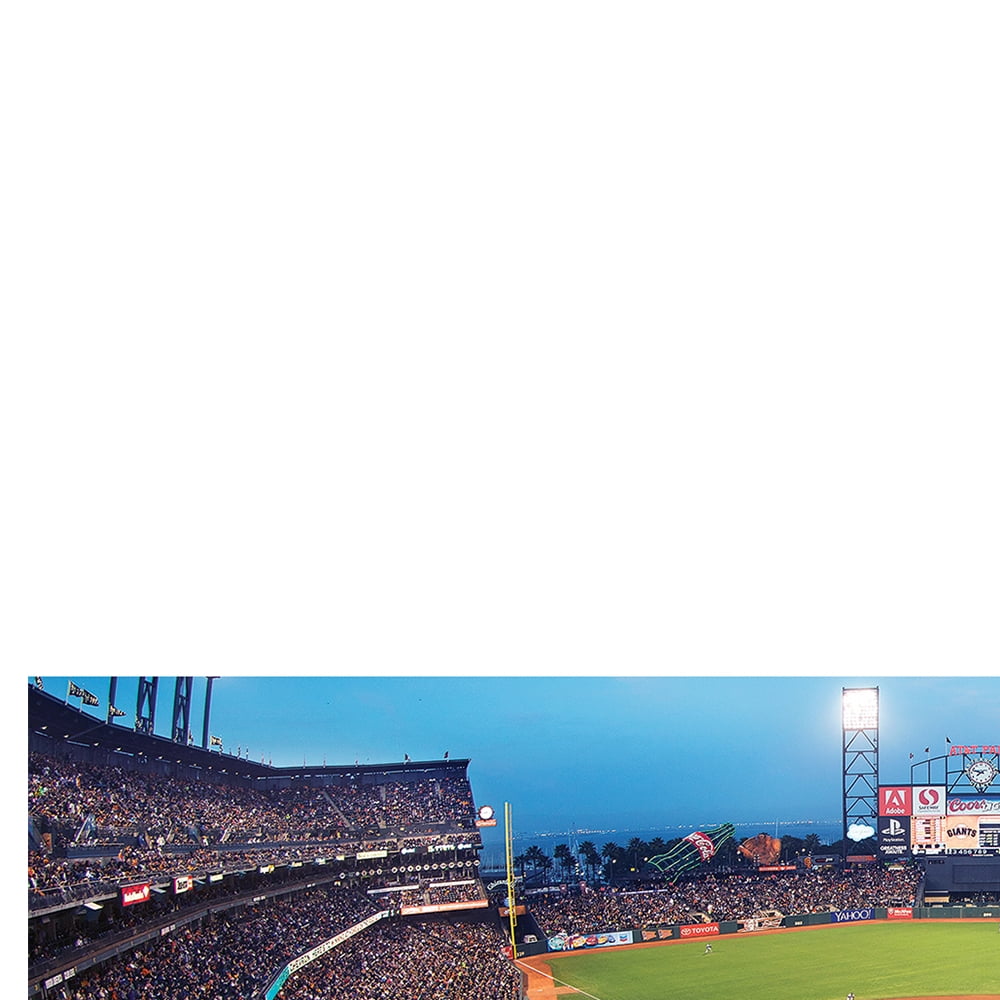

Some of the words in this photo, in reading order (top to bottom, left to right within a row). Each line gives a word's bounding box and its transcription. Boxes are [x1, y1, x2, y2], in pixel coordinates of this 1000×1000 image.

[949, 745, 978, 756] AT&T
[946, 827, 978, 838] GIANTS
[835, 909, 872, 922] YAHOO!
[692, 926, 719, 934] TOYOTA
